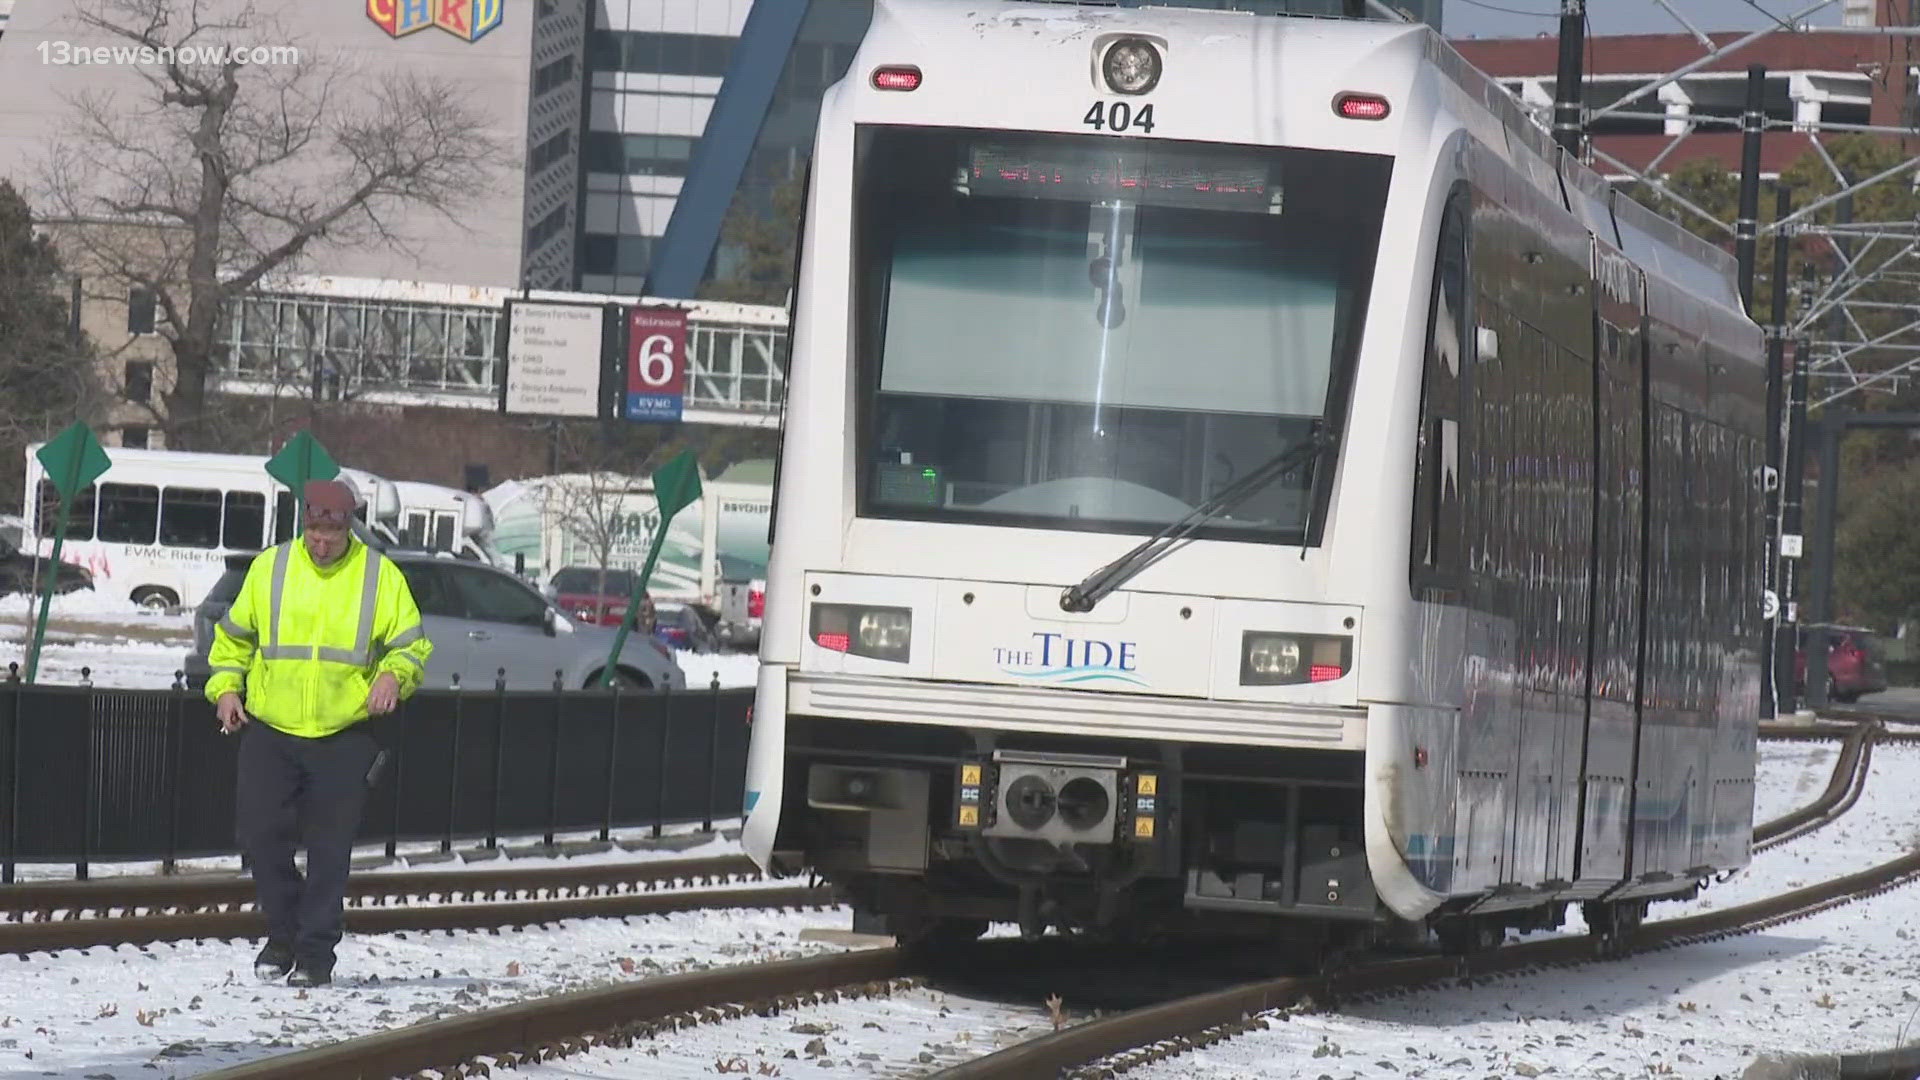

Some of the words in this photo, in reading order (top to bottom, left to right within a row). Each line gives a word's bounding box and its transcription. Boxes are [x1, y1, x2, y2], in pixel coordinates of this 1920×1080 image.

[371, 0, 501, 33] CHKD
[1083, 100, 1155, 134] 404
[639, 334, 674, 386] 6
[124, 544, 166, 560] EVMC
[171, 550, 202, 561] Ride
[206, 552, 226, 563] for
[993, 647, 1034, 666] THE
[1032, 632, 1137, 672] TIDE
